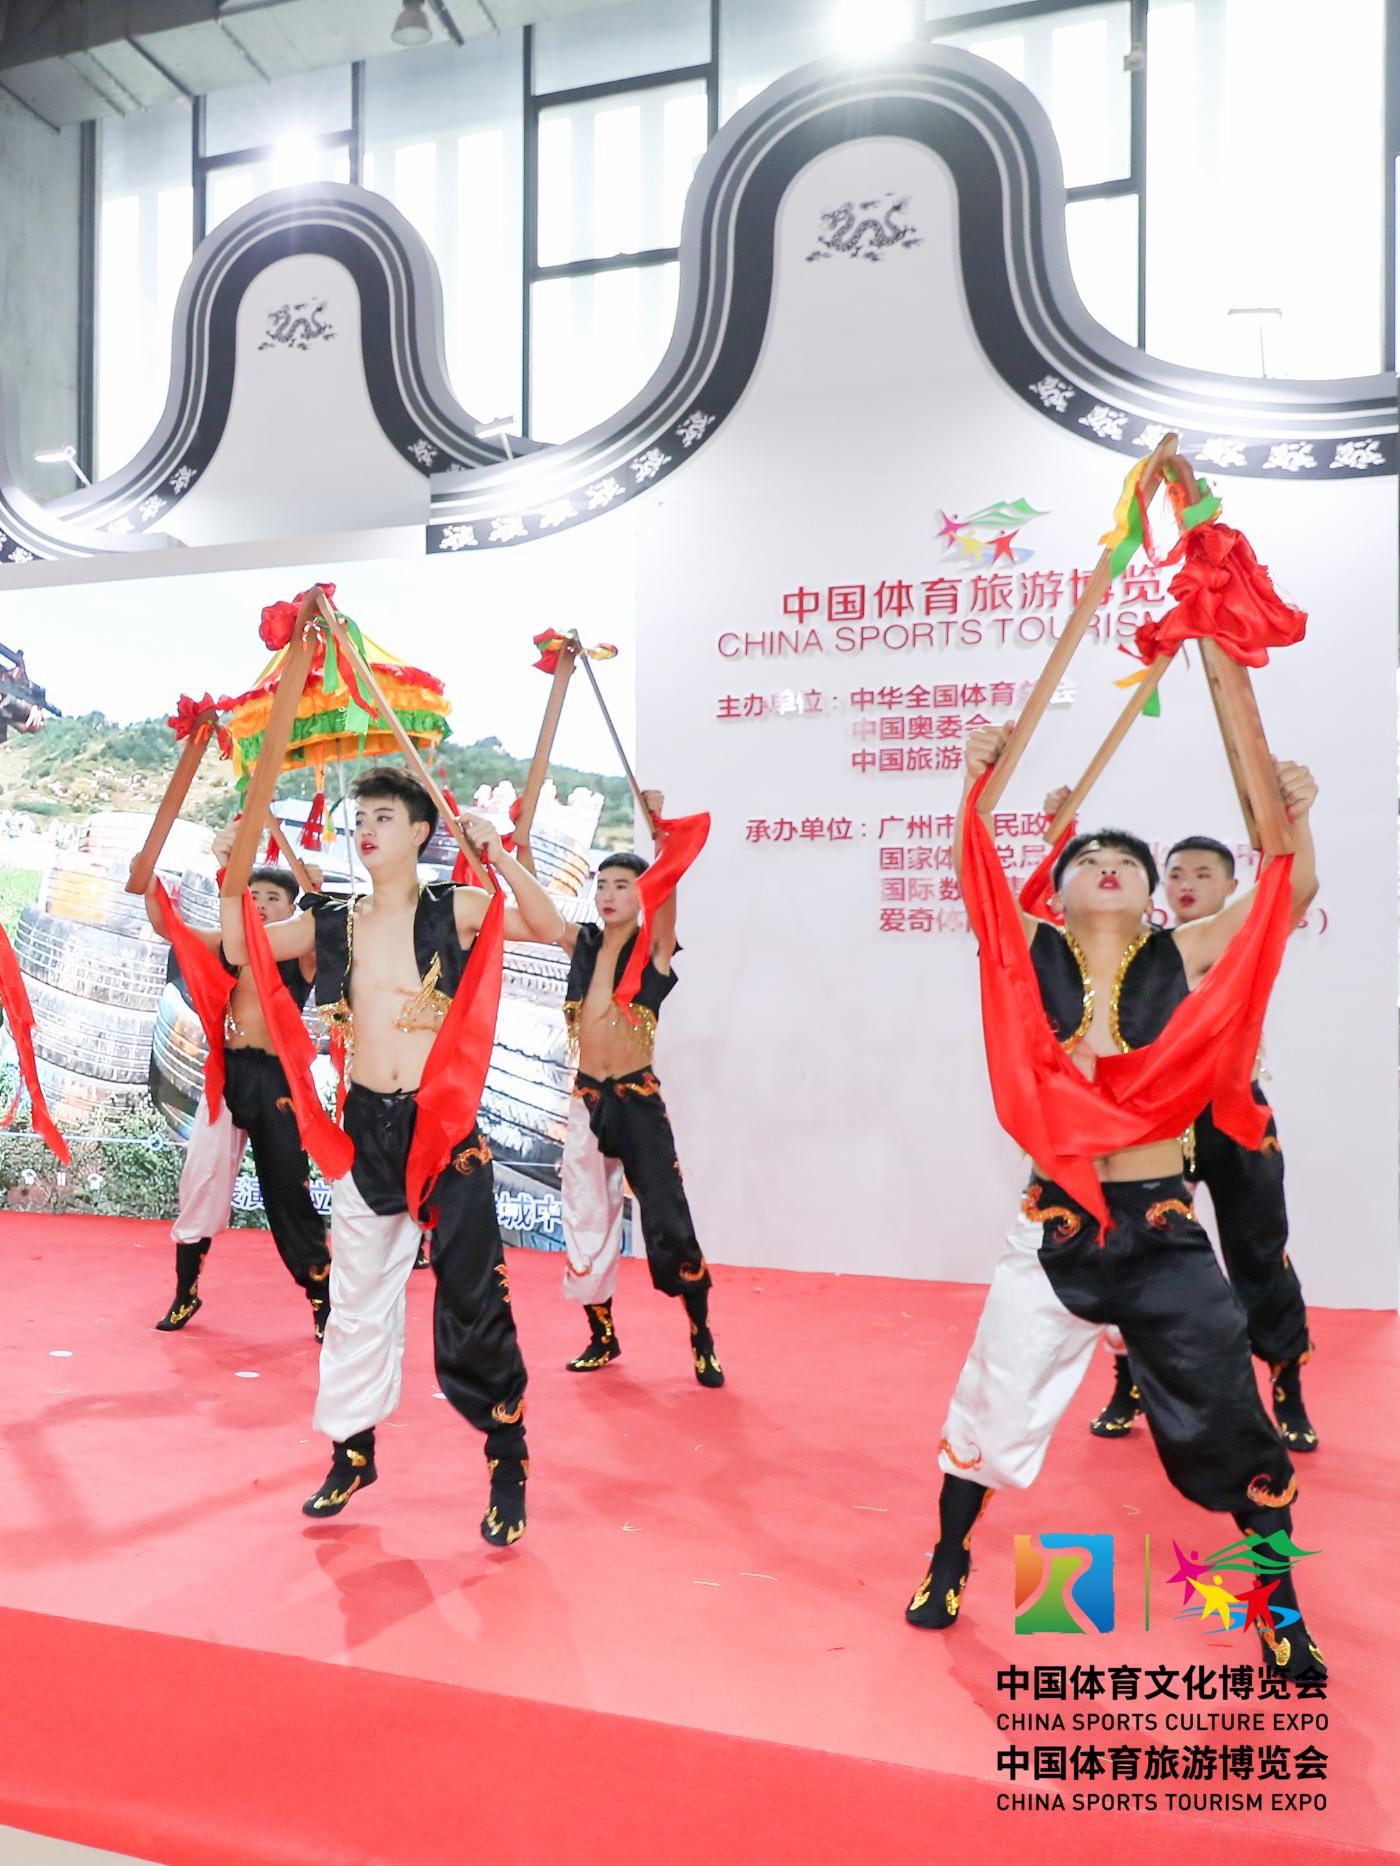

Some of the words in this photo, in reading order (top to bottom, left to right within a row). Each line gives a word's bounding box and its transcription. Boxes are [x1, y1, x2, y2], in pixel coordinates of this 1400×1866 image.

[718, 629, 823, 657] CHINA
[835, 618, 983, 652] SPORTS
[993, 610, 1152, 644] TOURIS
[851, 745, 963, 774] 中国旅游
